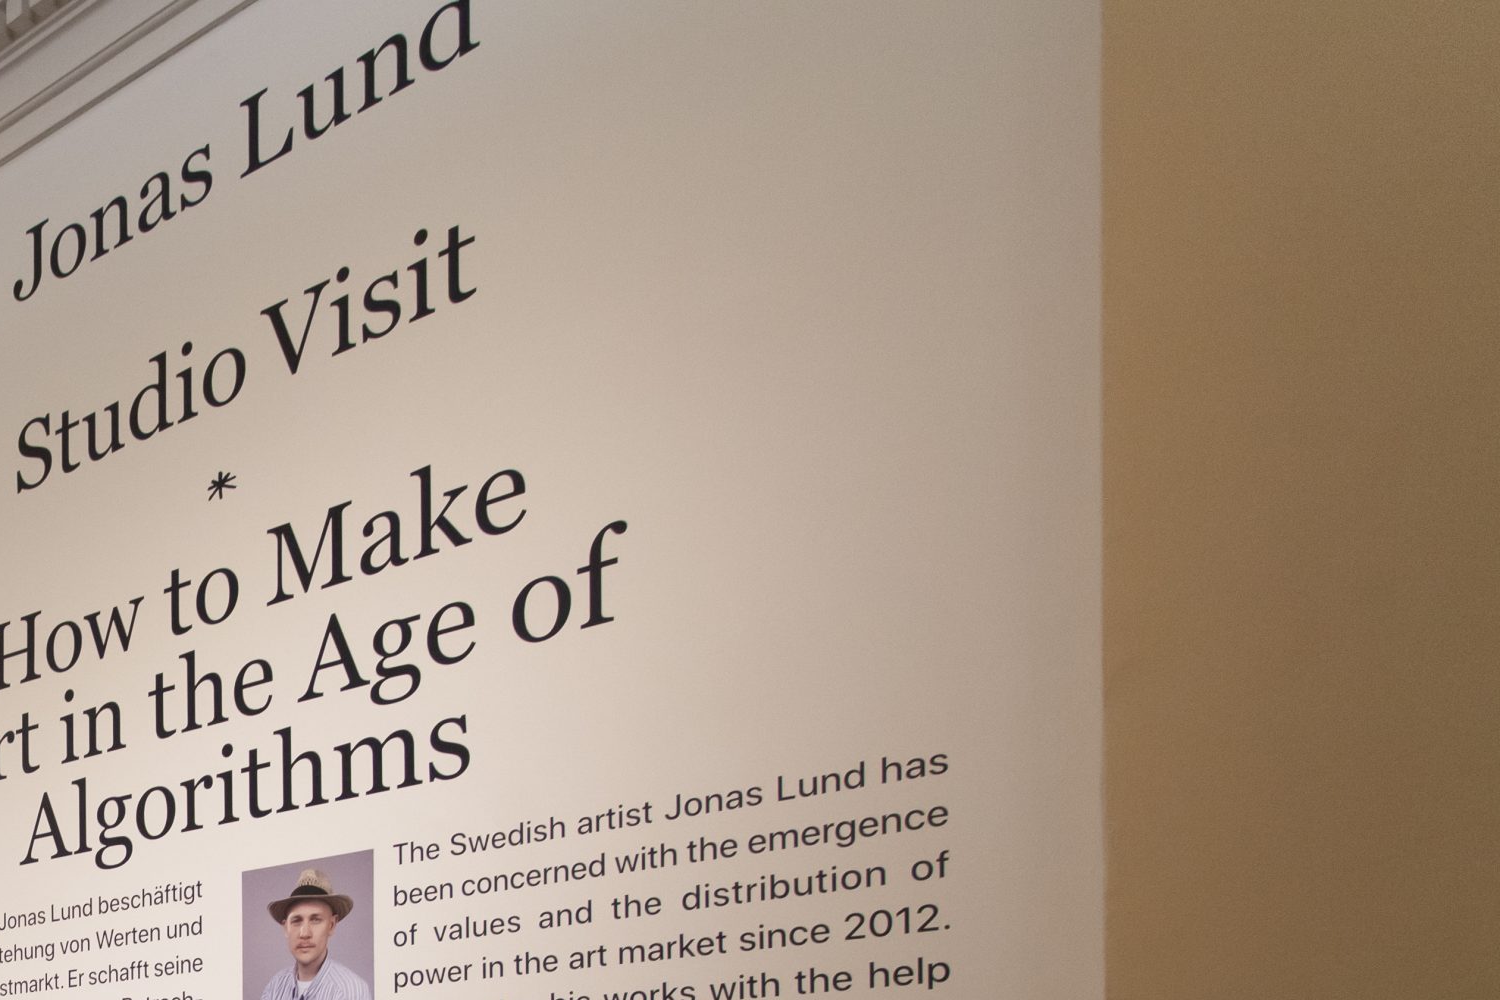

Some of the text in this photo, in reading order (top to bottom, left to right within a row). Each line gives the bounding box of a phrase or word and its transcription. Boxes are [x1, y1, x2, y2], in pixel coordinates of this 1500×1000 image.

[14, 0, 479, 301] Jonas Lund
[17, 226, 476, 493] Studio Visit
[164, 569, 238, 635] to
[267, 465, 526, 606] Make
[60, 690, 127, 764] in
[149, 651, 272, 738] the
[298, 602, 475, 704] Age
[513, 521, 627, 642] of
[19, 714, 470, 869] Algorithms
[392, 753, 949, 866] The Swedish artist Jonas Lund has
[50, 896, 94, 923] Lund
[97, 879, 204, 916] beschäftigt
[392, 849, 950, 948] of values and the distribution of
[393, 805, 949, 908] been concerned with the emergence
[67, 968, 85, 989] Er
[87, 959, 150, 986] schafft
[153, 954, 204, 978] seine
[393, 903, 951, 994] power in the art market since 2012.
[793, 966, 853, 996] the
[868, 956, 952, 991] help
